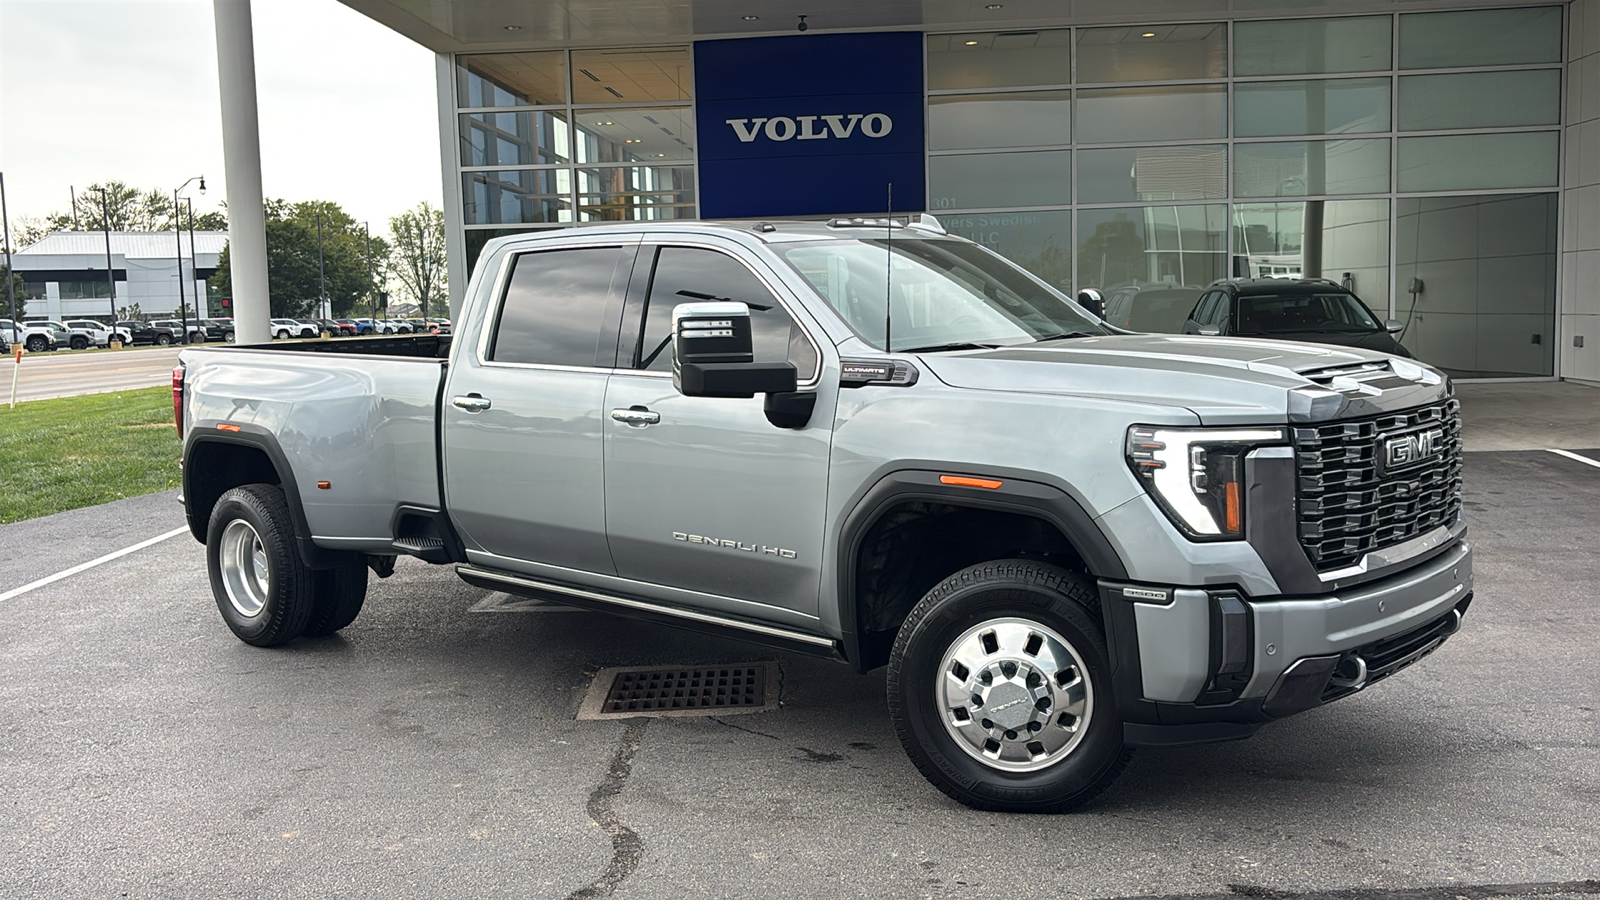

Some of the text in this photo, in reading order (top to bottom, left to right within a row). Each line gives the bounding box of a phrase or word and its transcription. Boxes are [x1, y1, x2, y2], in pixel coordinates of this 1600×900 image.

[726, 113, 893, 142] VOLVO
[932, 197, 957, 209] 301
[942, 214, 1041, 230] yers Swedish
[1386, 429, 1443, 468] GMC
[673, 531, 798, 559] DENALI HD
[1125, 589, 1165, 600] 3500
